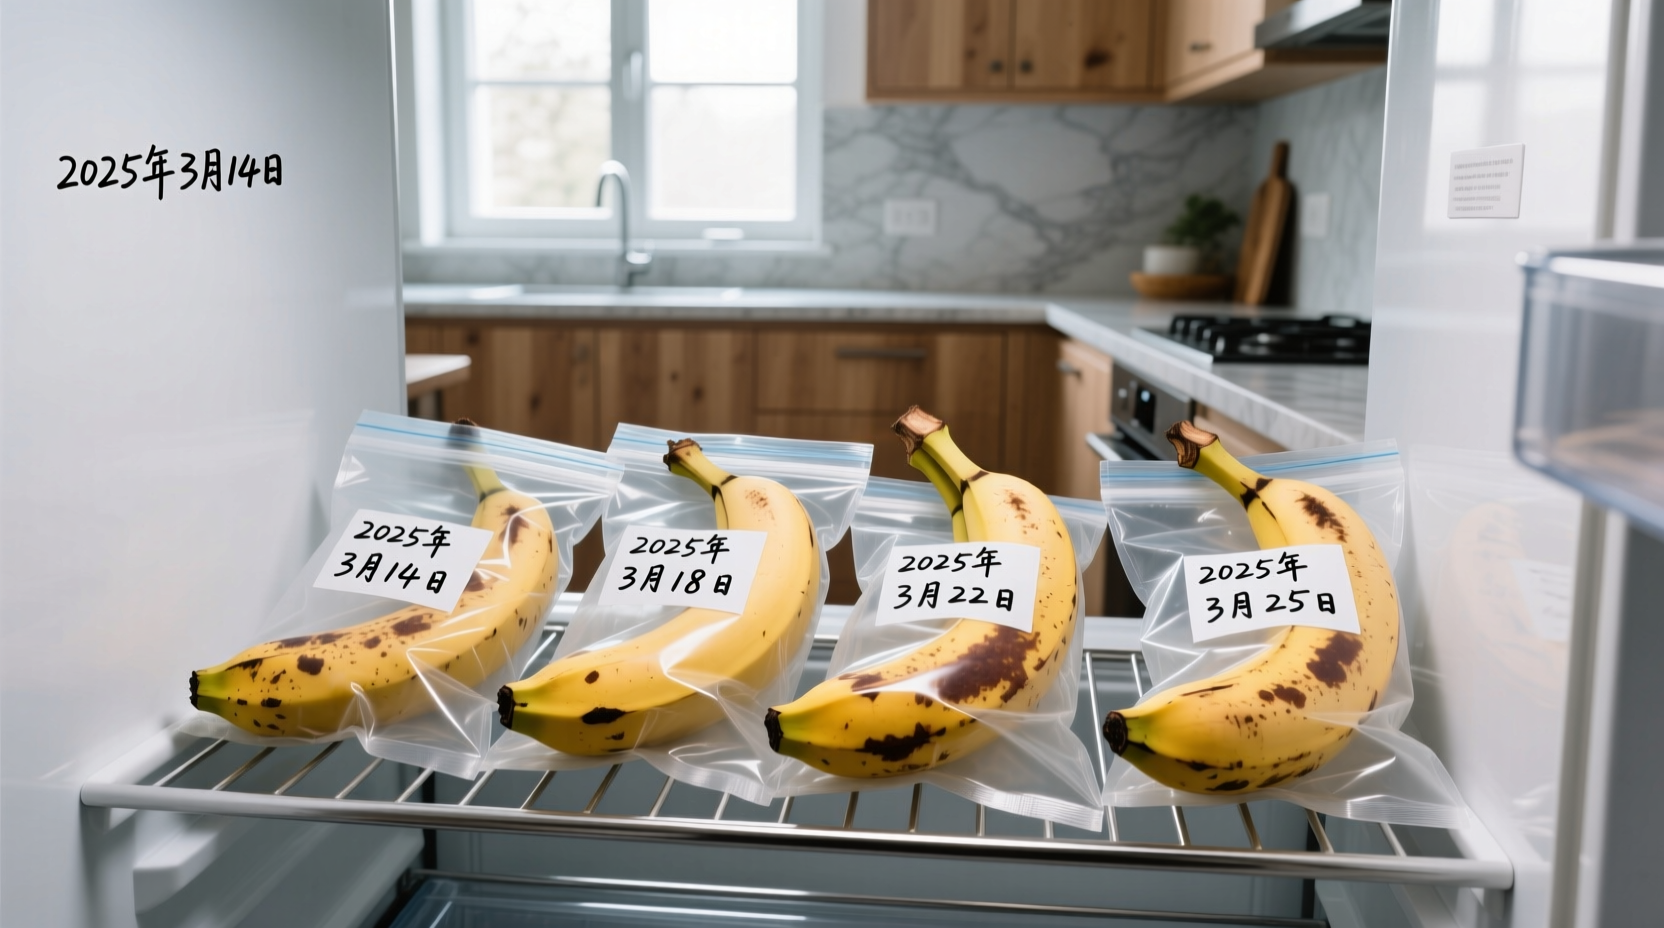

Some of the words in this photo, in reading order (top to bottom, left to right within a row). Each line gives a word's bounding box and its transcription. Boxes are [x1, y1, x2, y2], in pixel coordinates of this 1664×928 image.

[57, 144, 283, 201] 2025年3月14日
[353, 520, 451, 558] 2025年
[629, 533, 730, 564] 2025年
[333, 552, 448, 594] 3月14日
[898, 546, 1002, 578] 2025年
[1199, 551, 1308, 583] 2025年
[618, 563, 733, 596] 3月18日
[893, 581, 1014, 612] 3月22日
[1206, 589, 1336, 623] 3月25日
